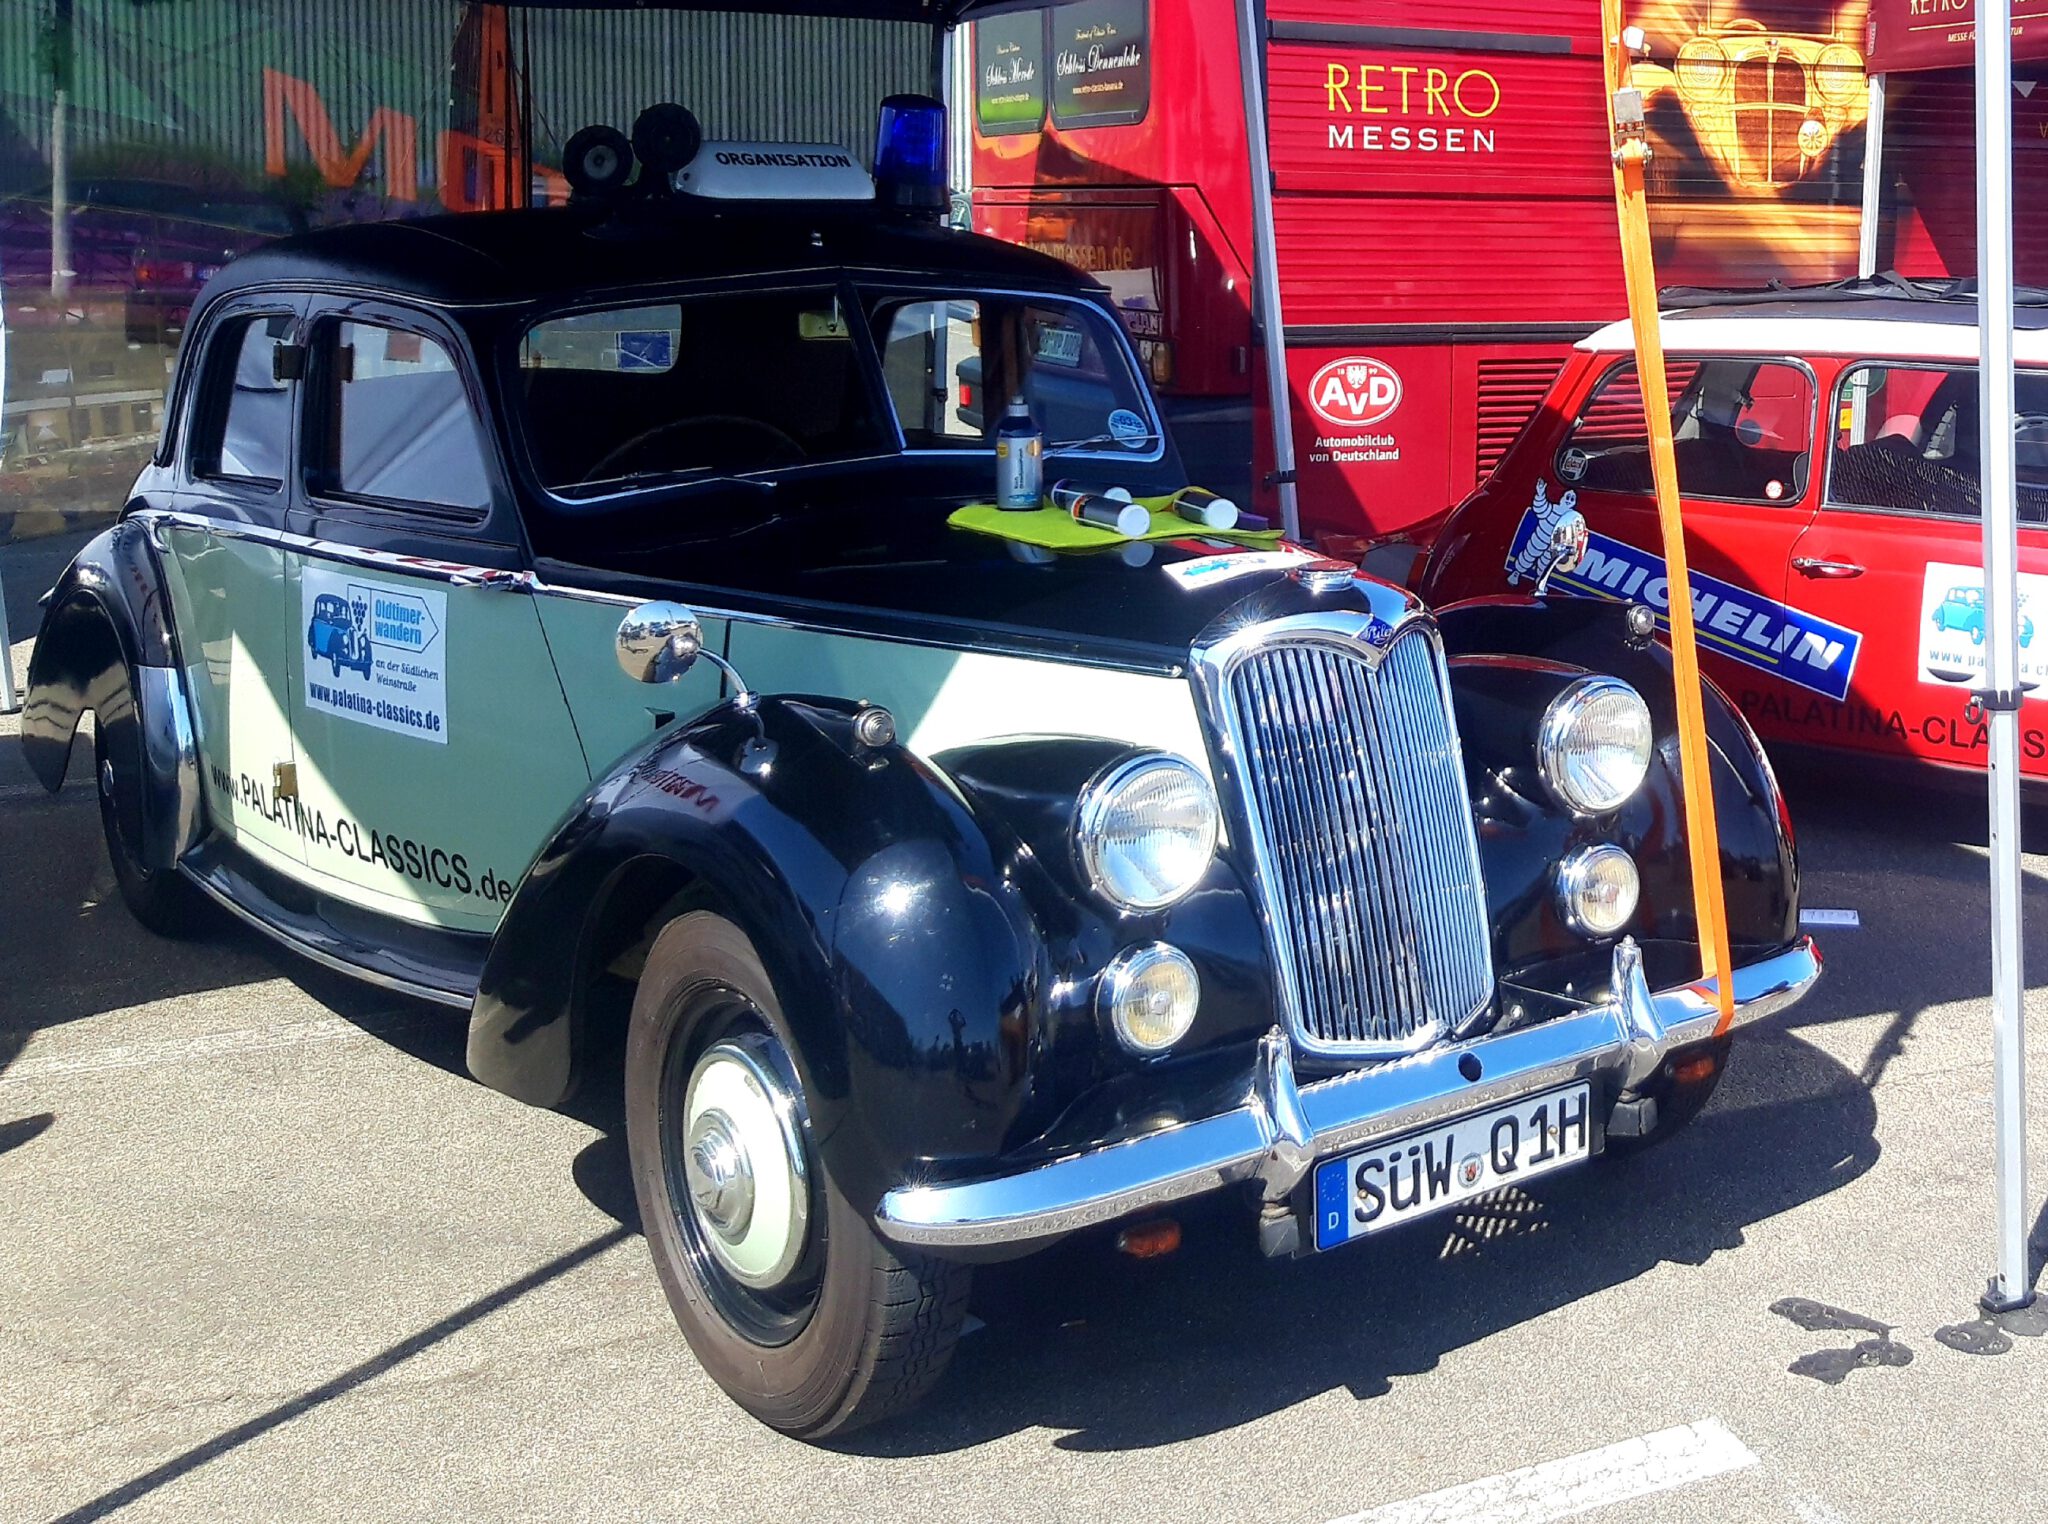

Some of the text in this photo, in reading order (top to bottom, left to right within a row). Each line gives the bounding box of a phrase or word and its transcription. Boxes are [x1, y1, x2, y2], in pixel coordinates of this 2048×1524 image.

[1948, 32, 1968, 42] MESSE
[1323, 63, 1501, 118] RETRO
[1328, 124, 1495, 152] MESSEN
[715, 152, 851, 168] ORGANISATION
[1315, 434, 1395, 448] Automobilclub
[1309, 448, 1400, 463] von Deutschland
[375, 597, 425, 626] Oldtimer-
[374, 620, 422, 645] wandern
[376, 659, 439, 681] an der Südlichen
[376, 672, 417, 693] Weinstraße
[309, 682, 441, 732] www.palatina-classics.de
[210, 763, 513, 903] www.PALATINA-CLASSICS.de
[1354, 1133, 1455, 1223] SÜW
[1327, 1211, 1340, 1230] D
